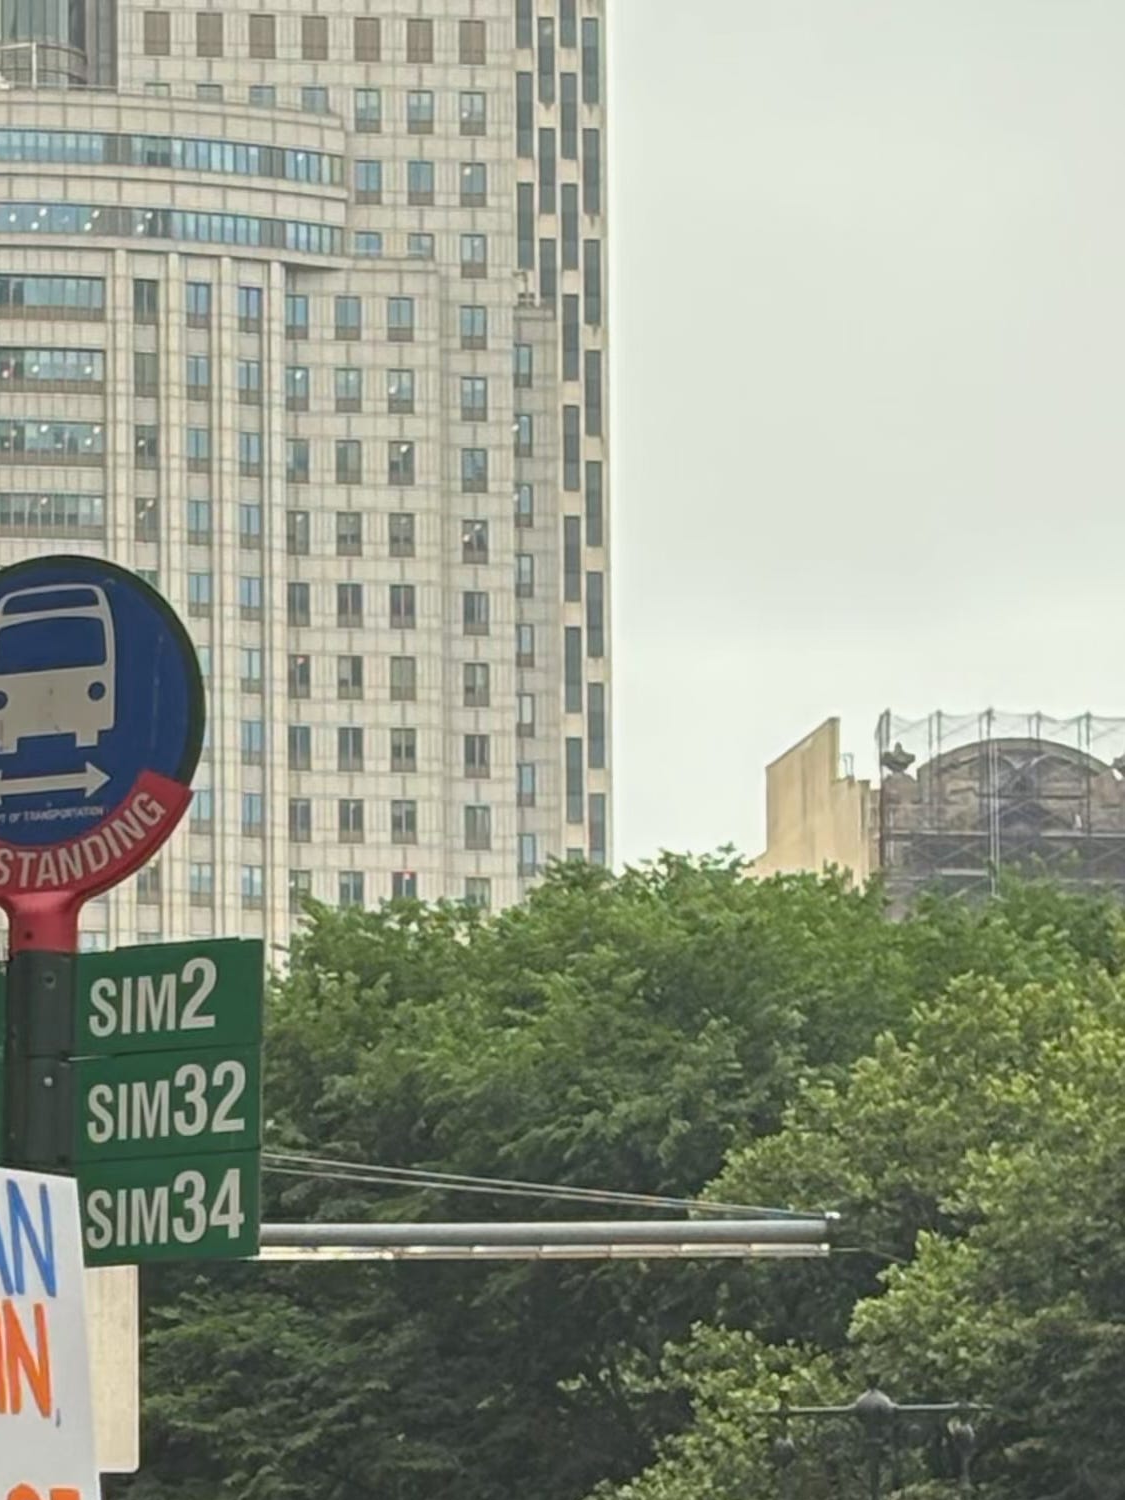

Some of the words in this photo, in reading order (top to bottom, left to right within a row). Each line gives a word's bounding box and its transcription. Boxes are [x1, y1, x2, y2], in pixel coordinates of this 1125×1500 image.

[88, 956, 217, 1038] SIM2
[86, 1060, 246, 1144] SIM32
[85, 1167, 245, 1250] SIM34
